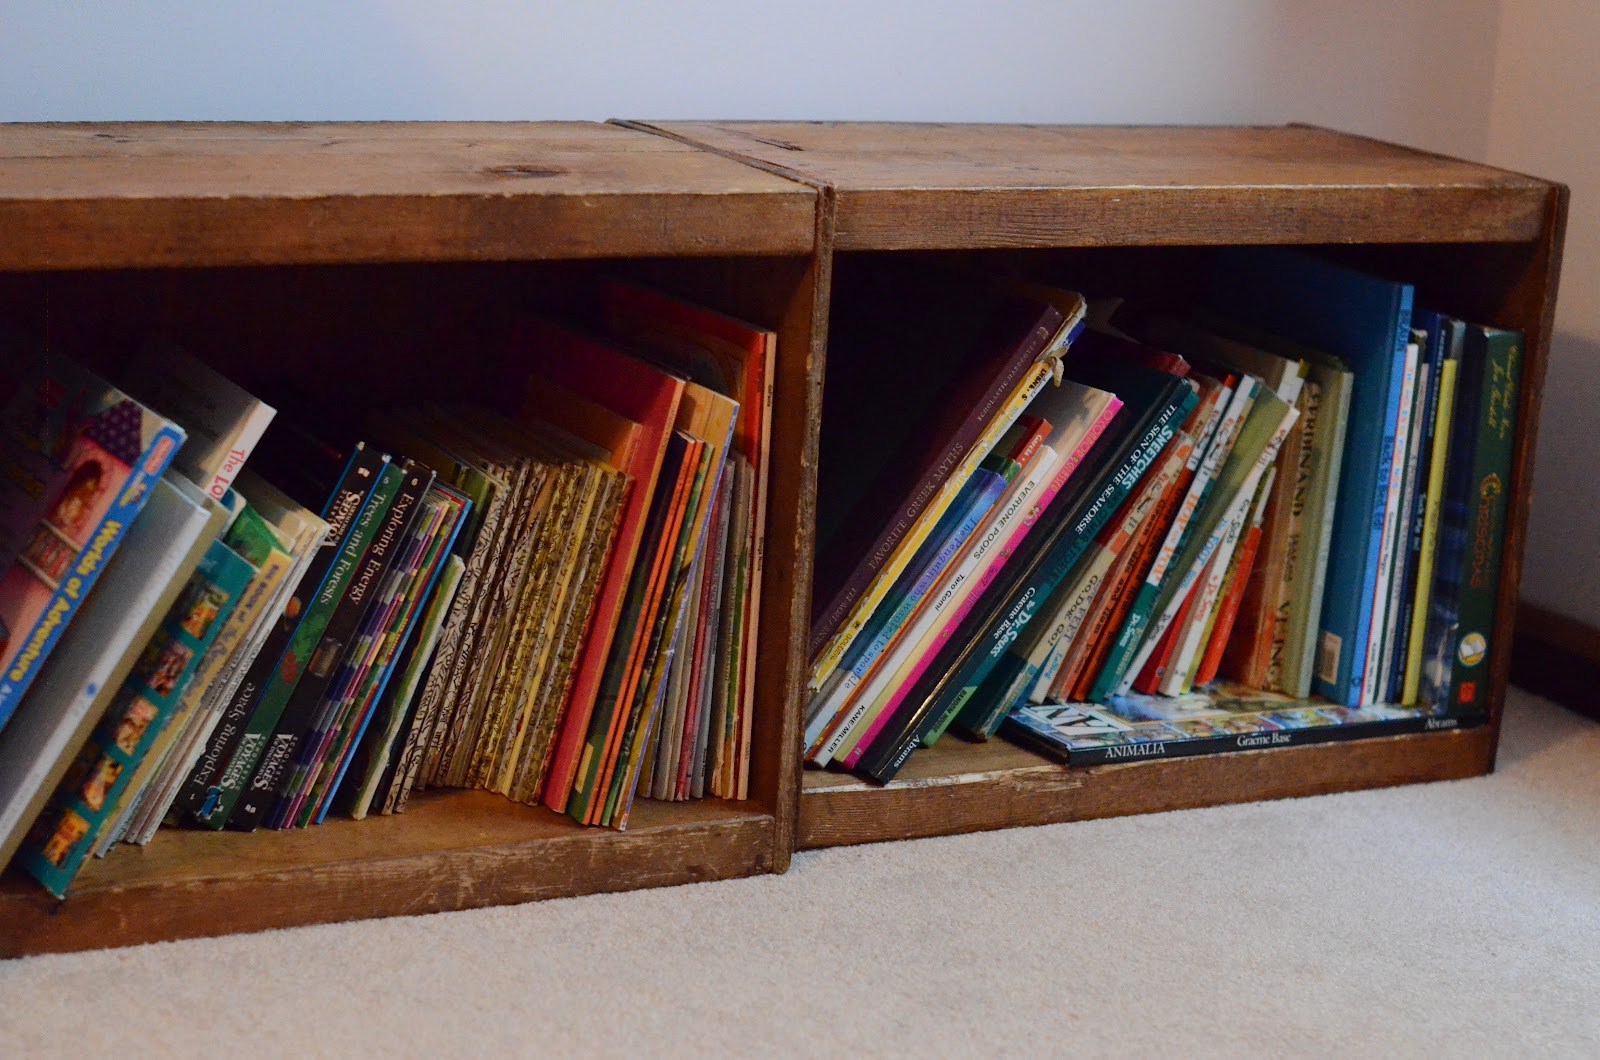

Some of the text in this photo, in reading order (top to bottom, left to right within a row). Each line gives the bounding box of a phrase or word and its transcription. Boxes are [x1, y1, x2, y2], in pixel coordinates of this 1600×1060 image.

[976, 378, 1009, 422] SCHOLASTIC
[220, 444, 249, 476] The
[1022, 432, 1044, 457] Garcia
[1117, 423, 1176, 491] SNEETCHES
[1071, 402, 1178, 535] THE SIGN OF THE SEAHORSE
[321, 490, 362, 551] VOYAGES
[867, 518, 908, 570] FAVORITE
[905, 479, 937, 519] GREEK
[931, 441, 965, 483] MYTHS
[995, 479, 1036, 528] EVERYONE
[317, 489, 387, 607] Trees and Forests
[346, 490, 414, 607] Exploring Energy
[958, 516, 978, 539] The
[971, 526, 1000, 560] POOPS
[1194, 532, 1221, 566] FOOT
[923, 535, 962, 583] Penguin
[7, 516, 122, 685] Worlds of Adventure
[909, 579, 931, 604] who
[932, 588, 953, 612] Gomi
[948, 572, 966, 592] Taro
[881, 599, 916, 642] wanted
[990, 585, 1037, 641] Graeme Base
[1045, 621, 1066, 647] Go!
[871, 638, 886, 655] to
[987, 624, 1020, 661] Seuss
[1117, 625, 1135, 649] Seuss
[839, 648, 877, 692] sparkle
[191, 720, 239, 787] Exploring
[226, 680, 258, 722] Space
[825, 704, 866, 754] KANE/MILLER
[890, 732, 923, 770] Abrams
[1103, 713, 1458, 760] ANIMALIA Graeme Base Abrams
[221, 733, 262, 789] VOYAGES
[253, 733, 294, 790] VOYAGES
